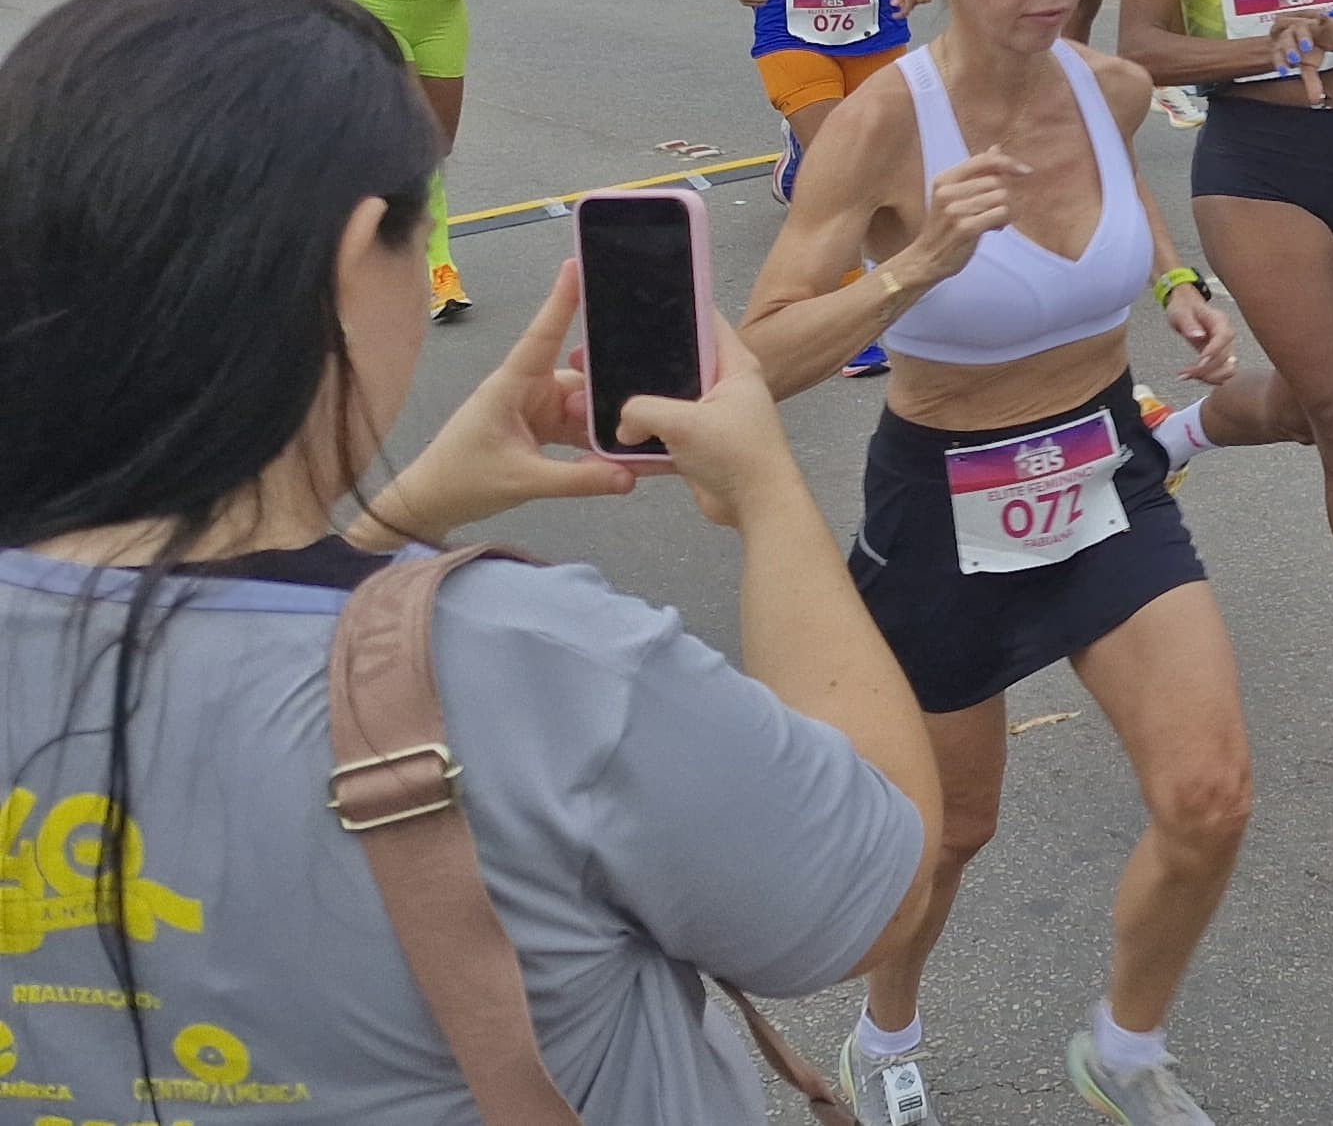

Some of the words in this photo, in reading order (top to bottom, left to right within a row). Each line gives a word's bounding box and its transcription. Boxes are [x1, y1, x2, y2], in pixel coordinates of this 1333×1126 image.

[813, 14, 855, 33] 076
[987, 486, 1026, 502] ELITE
[1002, 483, 1083, 539] 072
